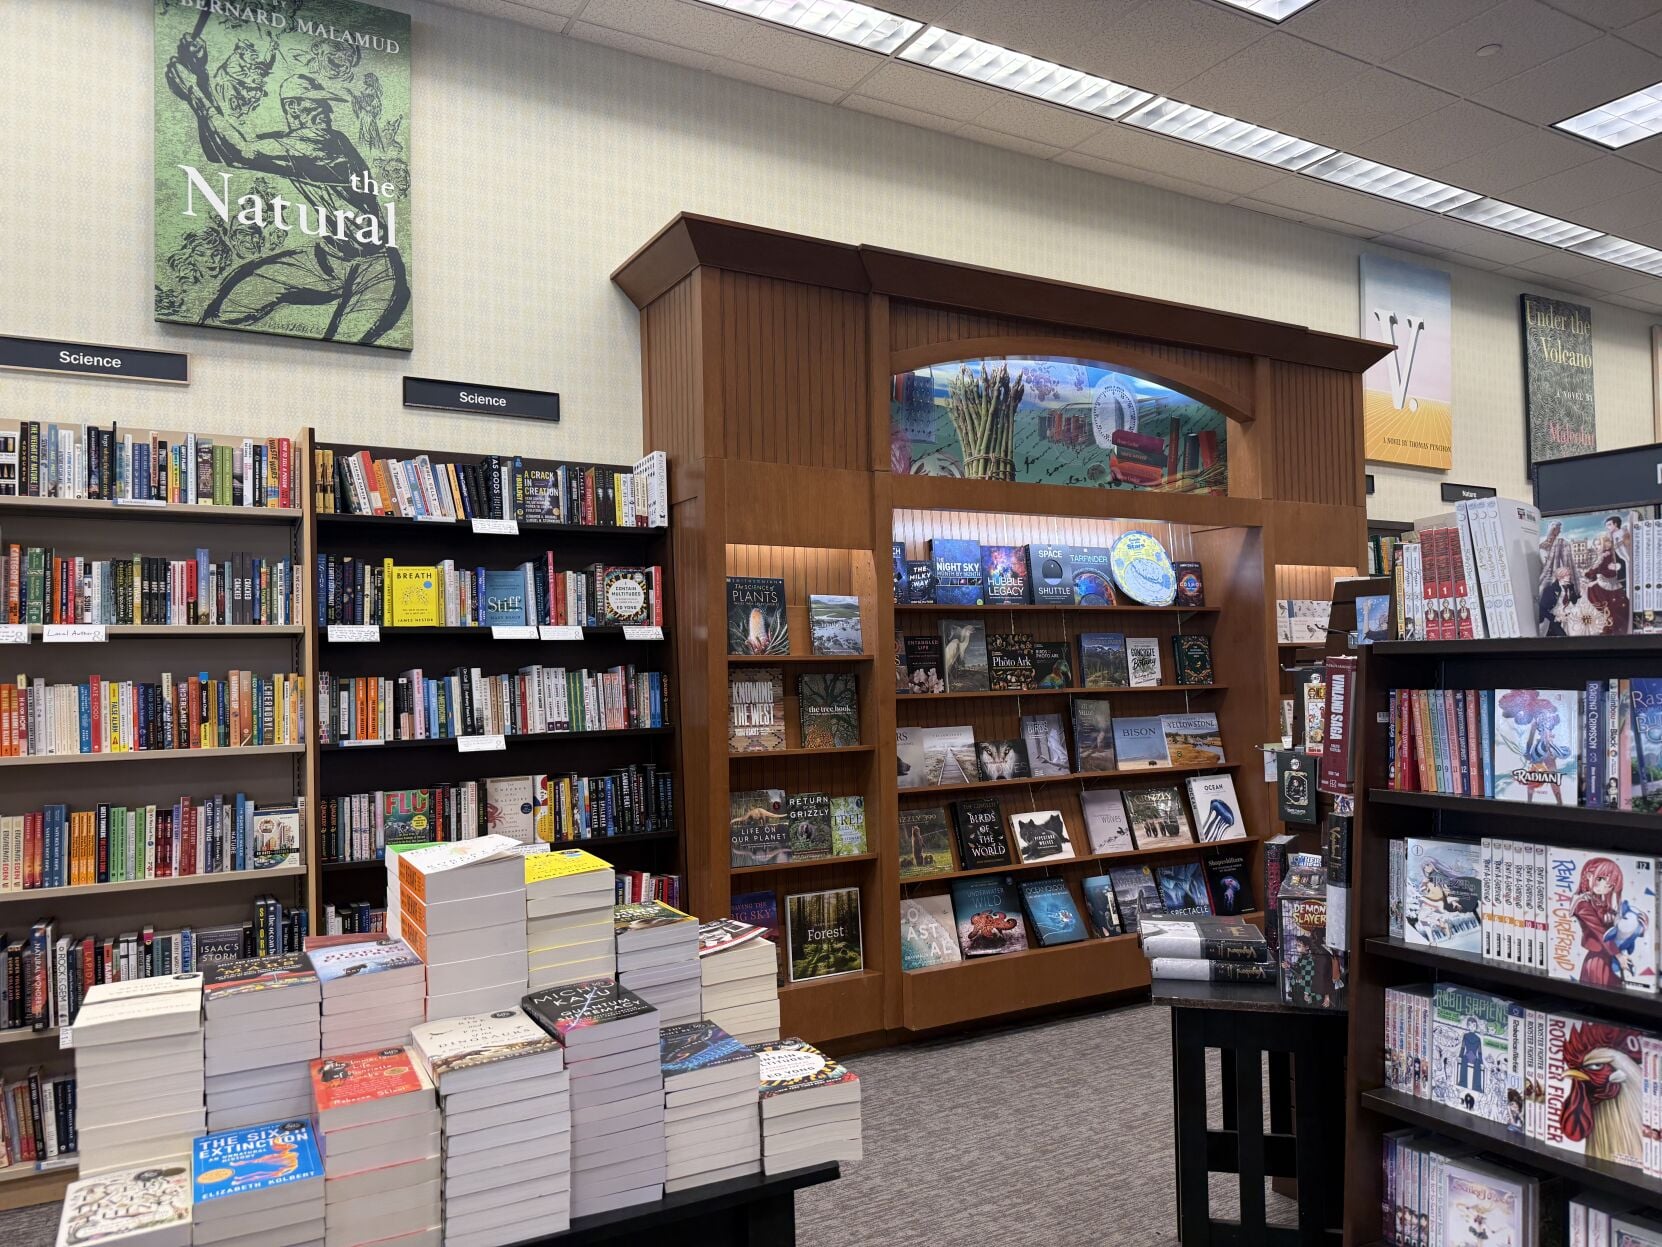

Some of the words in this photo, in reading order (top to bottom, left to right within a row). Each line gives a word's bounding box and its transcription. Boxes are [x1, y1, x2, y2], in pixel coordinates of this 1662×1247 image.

[297, 18, 400, 54] MALAMUD
[350, 171, 395, 198] the
[177, 164, 398, 249] Natural
[1526, 301, 1567, 331] Under
[1570, 311, 1591, 335] the
[59, 350, 122, 369] Science
[1540, 336, 1592, 369] Volcano
[459, 391, 507, 407] Science
[1563, 391, 1583, 401] NOVEL
[30, 424, 39, 433] THE
[30, 435, 39, 455] WEIGHT
[269, 440, 278, 460] WASTE
[1386, 438, 1401, 446] NOVEL
[1409, 440, 1429, 450] THOMAS
[1430, 444, 1452, 453] PYNCHON
[269, 461, 278, 479] WARS
[492, 458, 500, 469] AS
[30, 463, 39, 484] NATURE
[393, 471, 402, 490] Tamed
[524, 470, 529, 478] A
[530, 470, 554, 480] CRACK
[492, 471, 500, 494] GODS
[524, 488, 559, 496] CREATION
[1039, 550, 1062, 558] SPACE
[10, 547, 19, 582] CATEGORY
[936, 563, 961, 571] NIGHT
[963, 563, 979, 571] SKY
[396, 572, 432, 580] BREATH
[910, 573, 931, 581] MILKY
[988, 577, 1024, 586] HUBBLE
[10, 586, 19, 601] FIVE
[596, 565, 604, 614] TRANSCENDENCE
[733, 590, 778, 602] PLANTS
[989, 587, 1024, 596] LEGACY
[1039, 587, 1070, 595] SHUTTLE
[488, 596, 522, 614] Stiff
[1130, 648, 1155, 656] CONCRETE
[1017, 657, 1031, 666] Ark
[1132, 657, 1156, 670] Botany
[732, 681, 774, 704] KNOWING
[1330, 675, 1345, 713] VINLAND
[1589, 683, 1598, 710] RAGNA
[264, 686, 273, 732] CHERNOBYL
[733, 703, 750, 725] THE
[750, 703, 774, 726] WEST
[1027, 725, 1048, 733] BIRDS
[1167, 720, 1216, 728] YELLOWSTONE
[1329, 714, 1343, 739] SAGA
[1589, 711, 1598, 749] CRIMSON
[1123, 728, 1156, 736] BISON
[1512, 769, 1567, 786] RADIANT
[385, 790, 427, 816] FLU
[790, 796, 828, 805] RETURN
[1135, 793, 1172, 802] GRIZZLY
[1189, 787, 1197, 810] OCEAN
[790, 809, 829, 818] GRIZZLY
[834, 814, 862, 826] TREE
[968, 812, 995, 823] BIRDS
[980, 825, 989, 833] OF
[732, 835, 750, 843] OUR
[979, 835, 994, 843] THE
[972, 845, 1005, 857] WORLD
[968, 888, 1004, 897] UNDERWATER
[973, 895, 1001, 908] WILD
[1294, 903, 1327, 914] DEMON
[751, 909, 772, 920] SKY
[1293, 913, 1327, 924] SLAYER
[808, 926, 844, 941] Forest
[907, 924, 937, 941] AST
[201, 942, 239, 952] ISAAC'S
[202, 951, 238, 961] STORM
[58, 953, 66, 977] ROCK
[58, 984, 66, 1002] GEM
[554, 989, 610, 1006] KAKU
[1437, 990, 1462, 1012] ROBO
[1466, 996, 1508, 1023] SAPIENS
[1549, 1019, 1566, 1081] ROOSTER
[784, 1067, 815, 1077] YONG
[1547, 1085, 1564, 1143] FIGHTER
[200, 1136, 238, 1150] THE
[200, 1132, 308, 1159] EXTINCTION
[222, 1154, 255, 1163] HISTORY
[202, 1182, 261, 1200] ELIZABETH
[268, 1172, 315, 1184] KOLBERT
